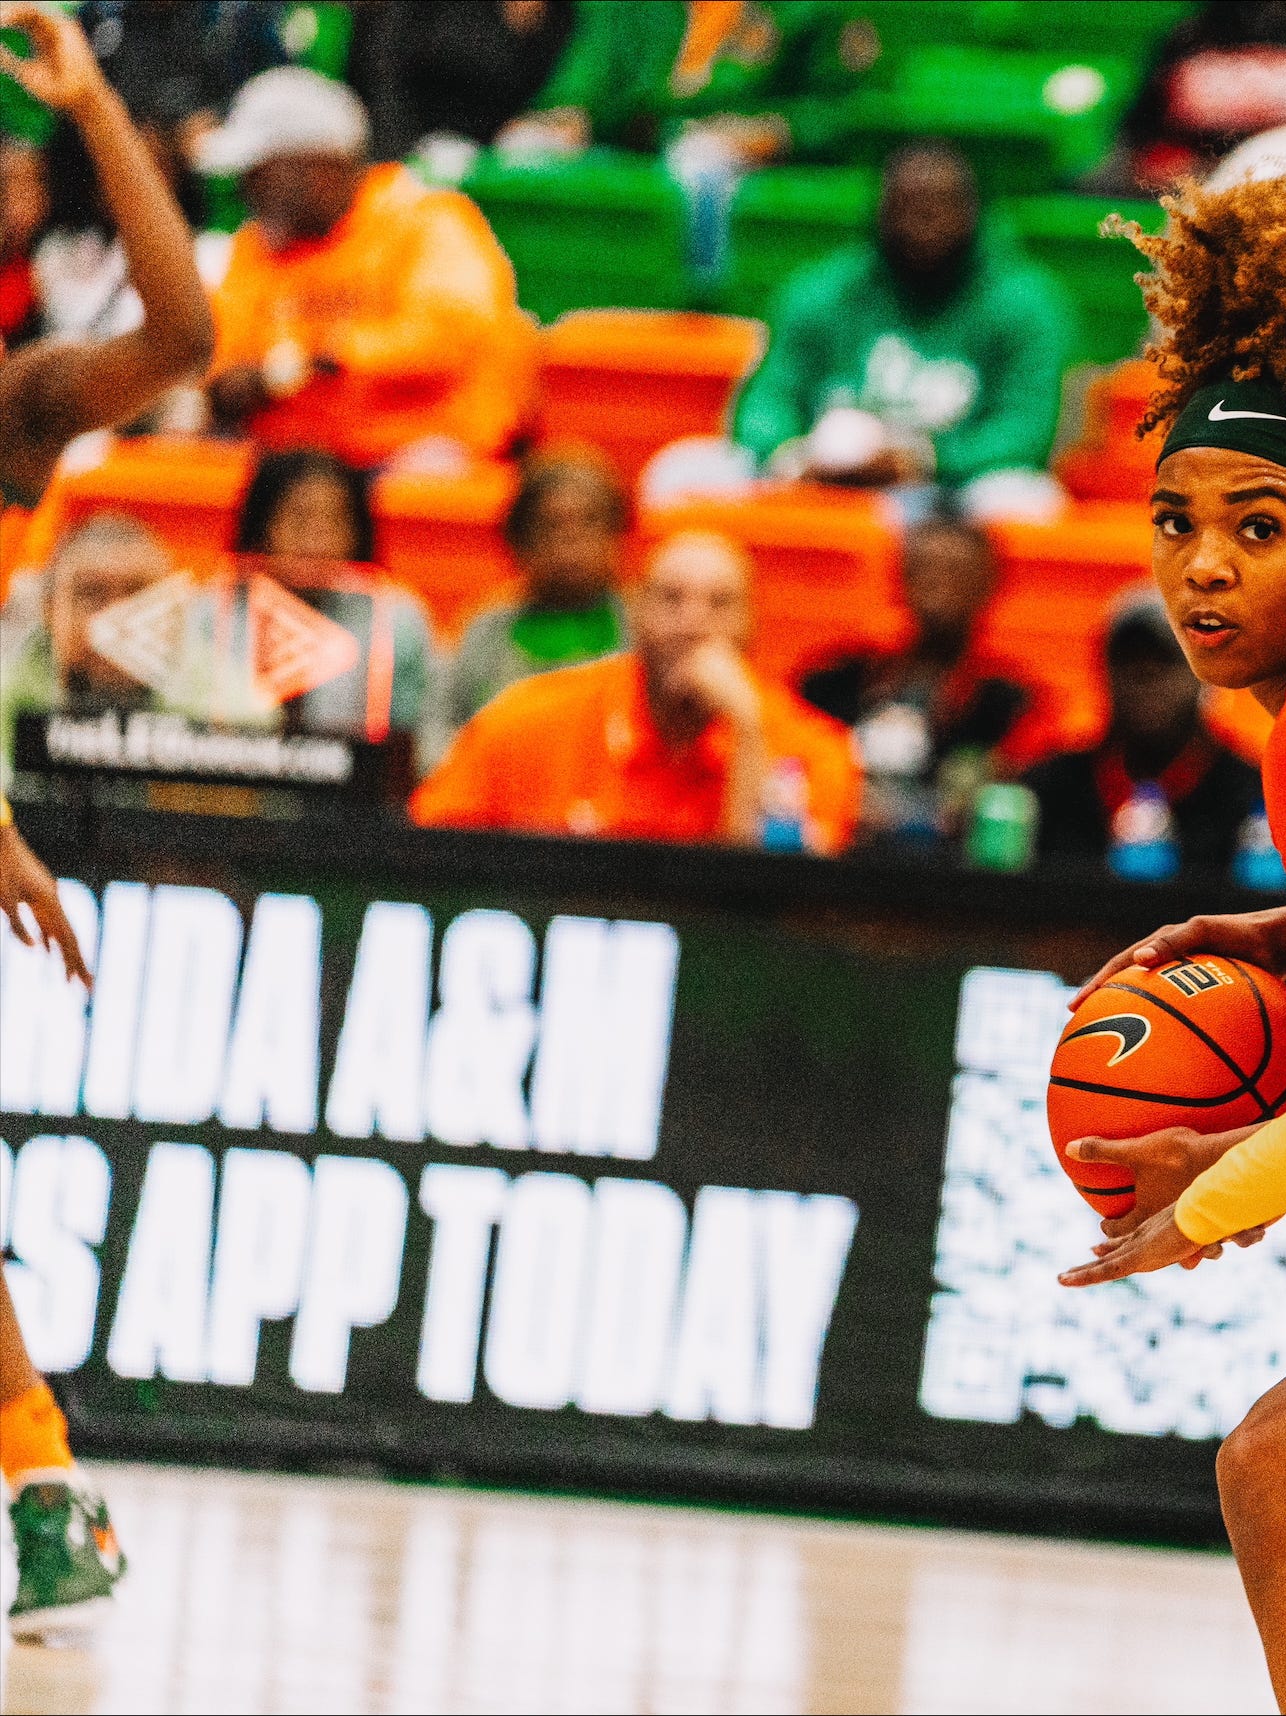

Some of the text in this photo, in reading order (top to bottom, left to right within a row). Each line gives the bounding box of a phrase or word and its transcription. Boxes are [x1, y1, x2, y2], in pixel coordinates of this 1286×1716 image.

[325, 901, 682, 1161] A&M
[0, 1134, 861, 1430] S APP TODAY
